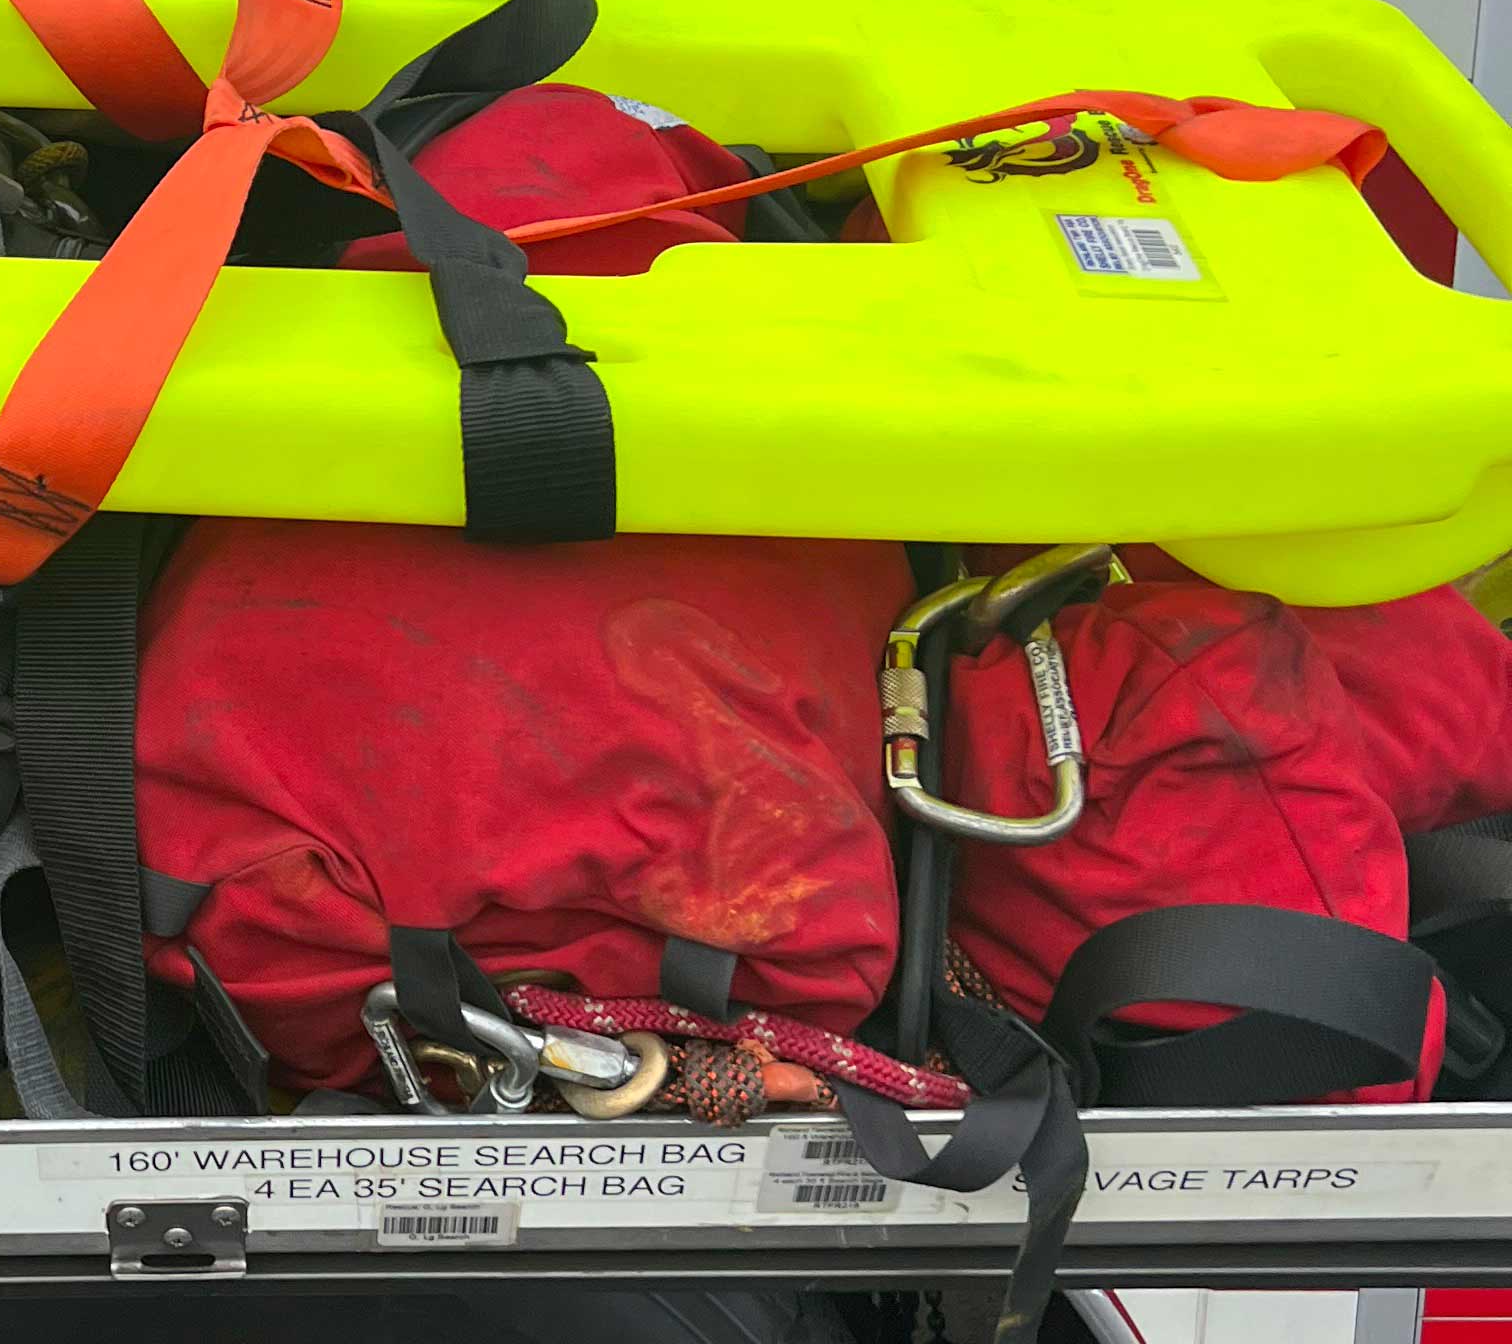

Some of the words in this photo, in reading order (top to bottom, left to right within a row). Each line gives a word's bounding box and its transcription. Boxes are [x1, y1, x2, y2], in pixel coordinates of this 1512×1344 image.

[1119, 159, 1157, 204] DragOne
[1035, 669, 1050, 700] FIRE
[1041, 704, 1060, 753] SHELLY
[109, 1150, 179, 1172] 160'
[193, 1146, 460, 1170] WAREHOUSE
[474, 1144, 645, 1167] SEARCH
[661, 1143, 746, 1165] BAG
[254, 1179, 275, 1199] 4
[289, 1178, 339, 1199] EA
[353, 1178, 405, 1199] 35'
[418, 1176, 586, 1198] SEARCH
[602, 1175, 685, 1197] BAG
[1012, 1169, 1209, 1192] SVAGE
[1223, 1168, 1360, 1189] TARPS
